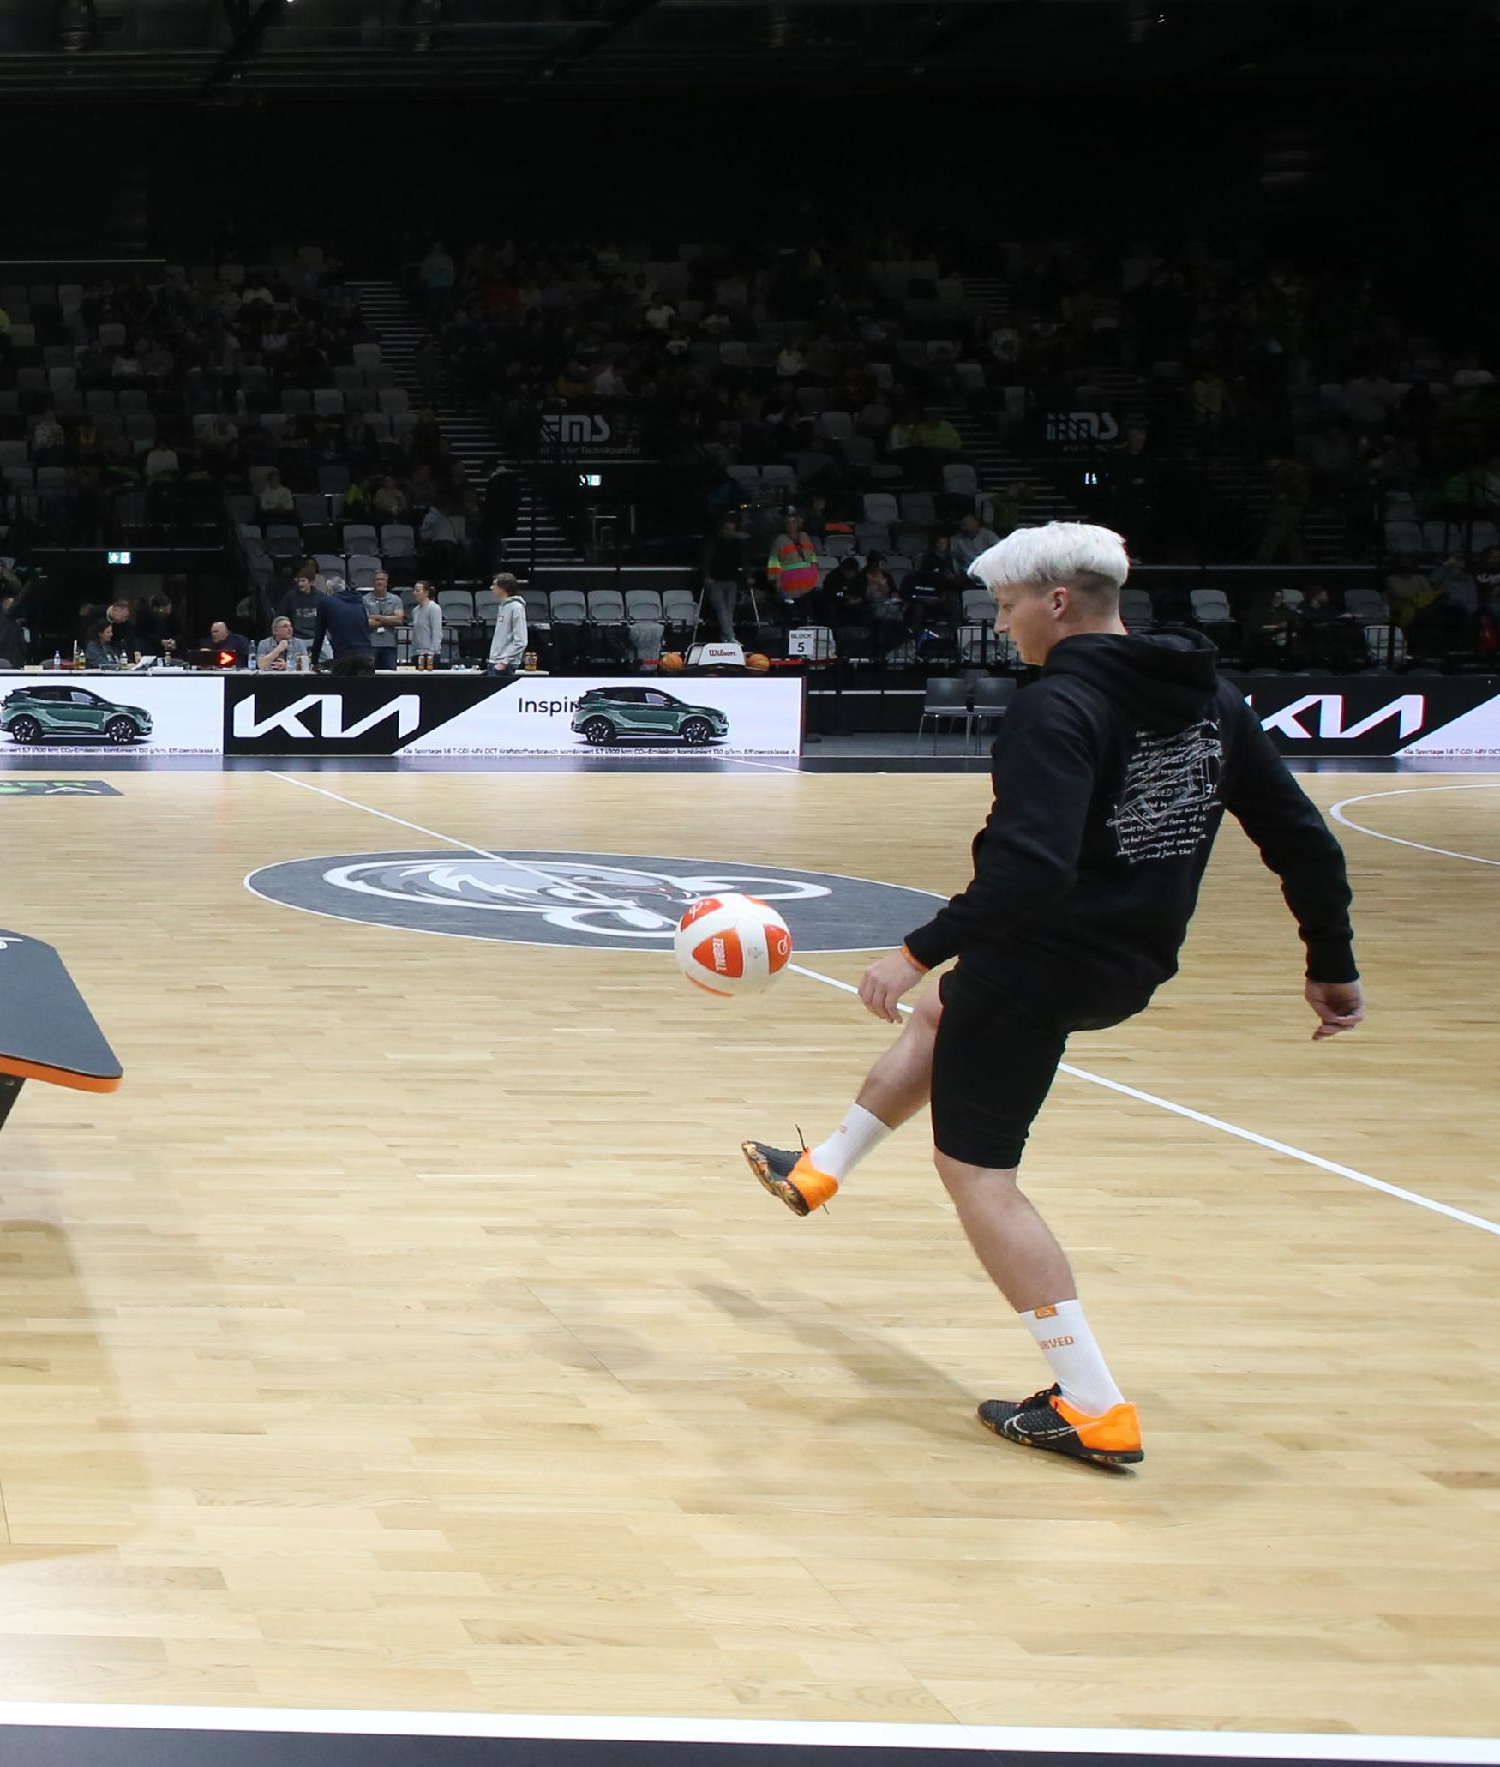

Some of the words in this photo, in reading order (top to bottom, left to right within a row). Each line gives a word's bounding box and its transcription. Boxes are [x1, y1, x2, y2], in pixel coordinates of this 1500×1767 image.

[708, 648, 736, 657] Wilson
[797, 642, 805, 653] 5
[713, 937, 728, 971] TEQBALL
